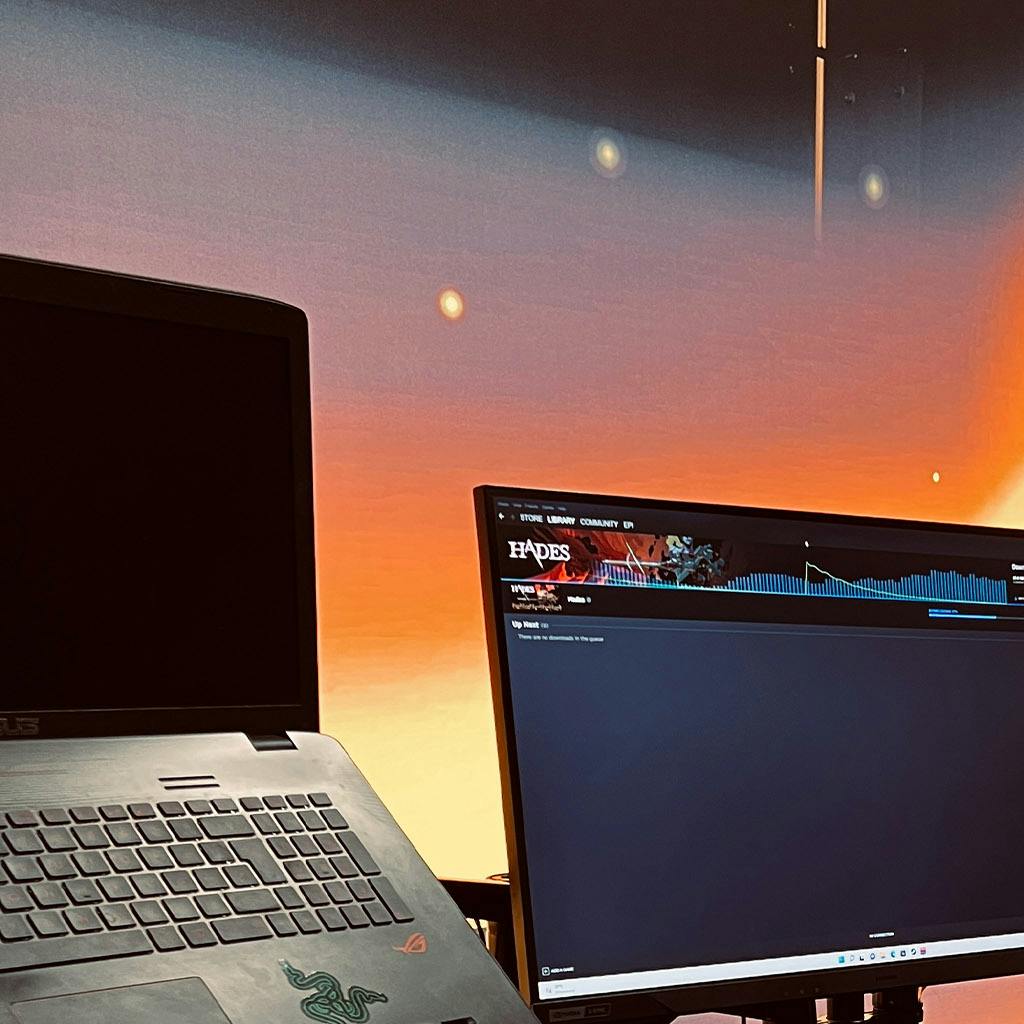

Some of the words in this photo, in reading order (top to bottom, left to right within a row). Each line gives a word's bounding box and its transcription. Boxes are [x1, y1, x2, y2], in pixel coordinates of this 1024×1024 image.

[520, 513, 543, 522] STORE
[547, 515, 575, 525] LIBRARY
[580, 518, 618, 528] COMMUNITY
[508, 539, 571, 569] HADES
[511, 620, 522, 629] Up
